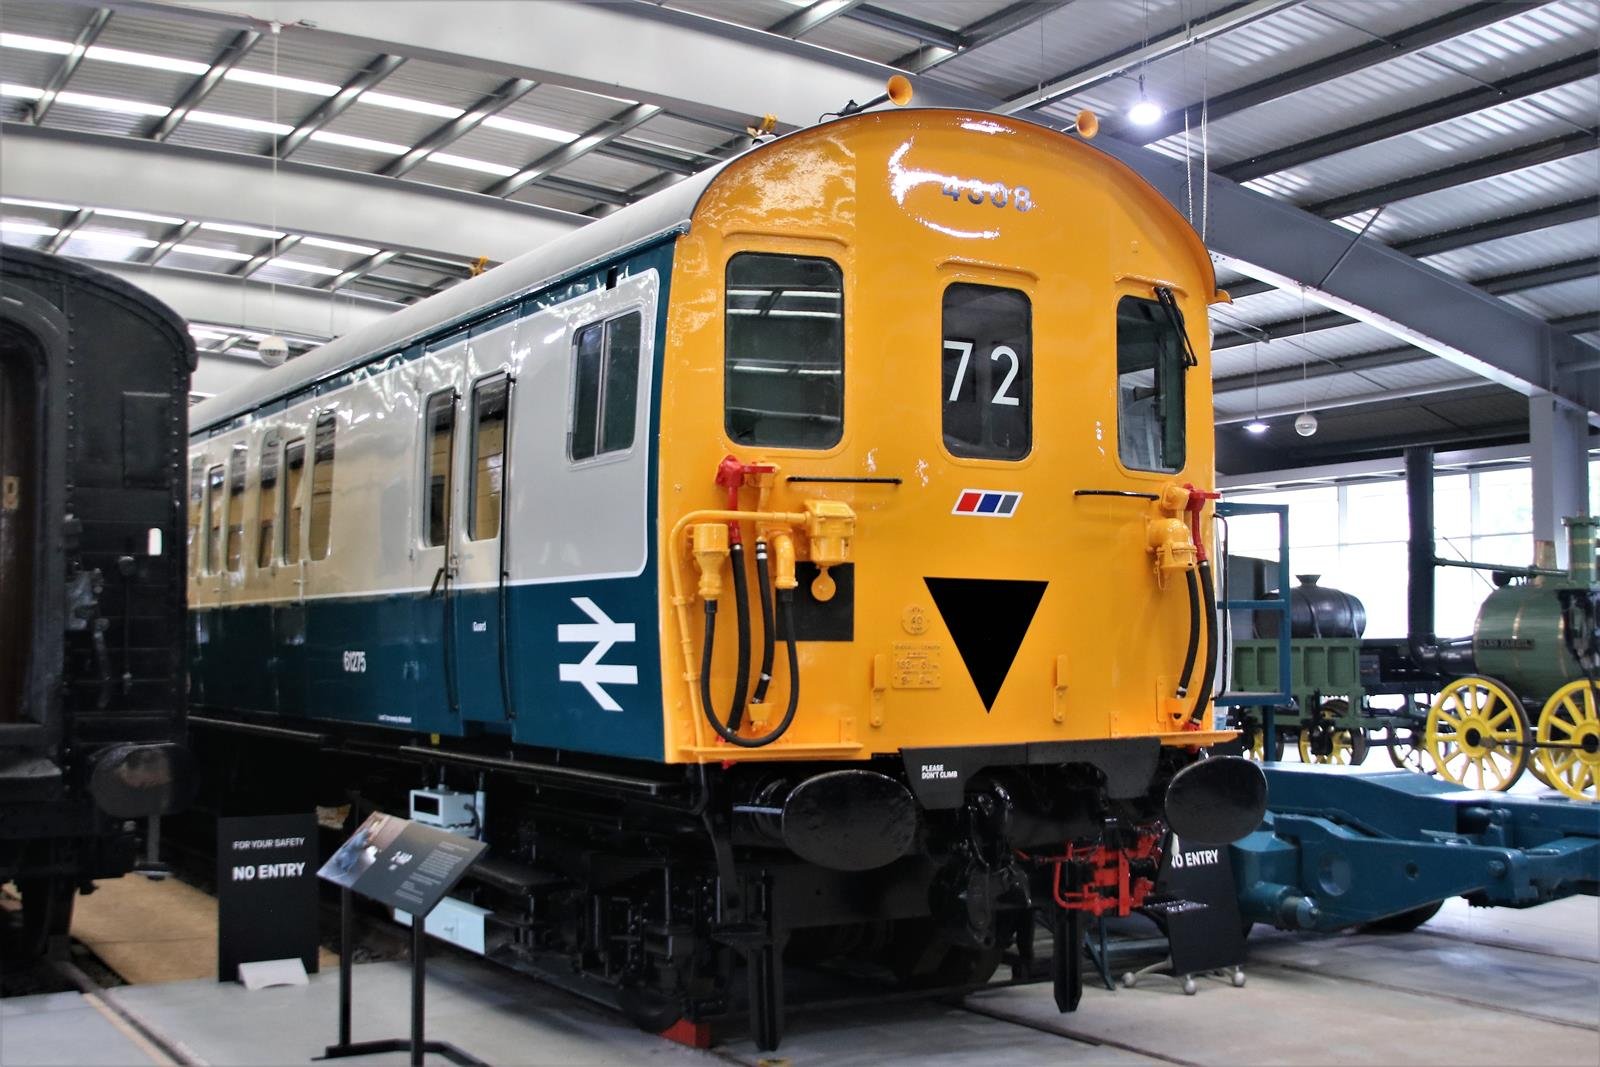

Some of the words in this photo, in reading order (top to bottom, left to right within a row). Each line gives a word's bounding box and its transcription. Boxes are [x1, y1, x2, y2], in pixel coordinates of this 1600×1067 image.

[344, 650, 367, 672] 61275
[921, 764, 944, 772] PLEASE
[921, 771, 939, 780] DON'T
[940, 770, 958, 779] CLIMB
[233, 840, 251, 850] FOR
[252, 839, 274, 849] YOUR
[275, 837, 305, 848] SAFETY
[1185, 848, 1218, 867] ENTRY
[233, 865, 256, 881] NO
[257, 862, 306, 879] ENTRY
